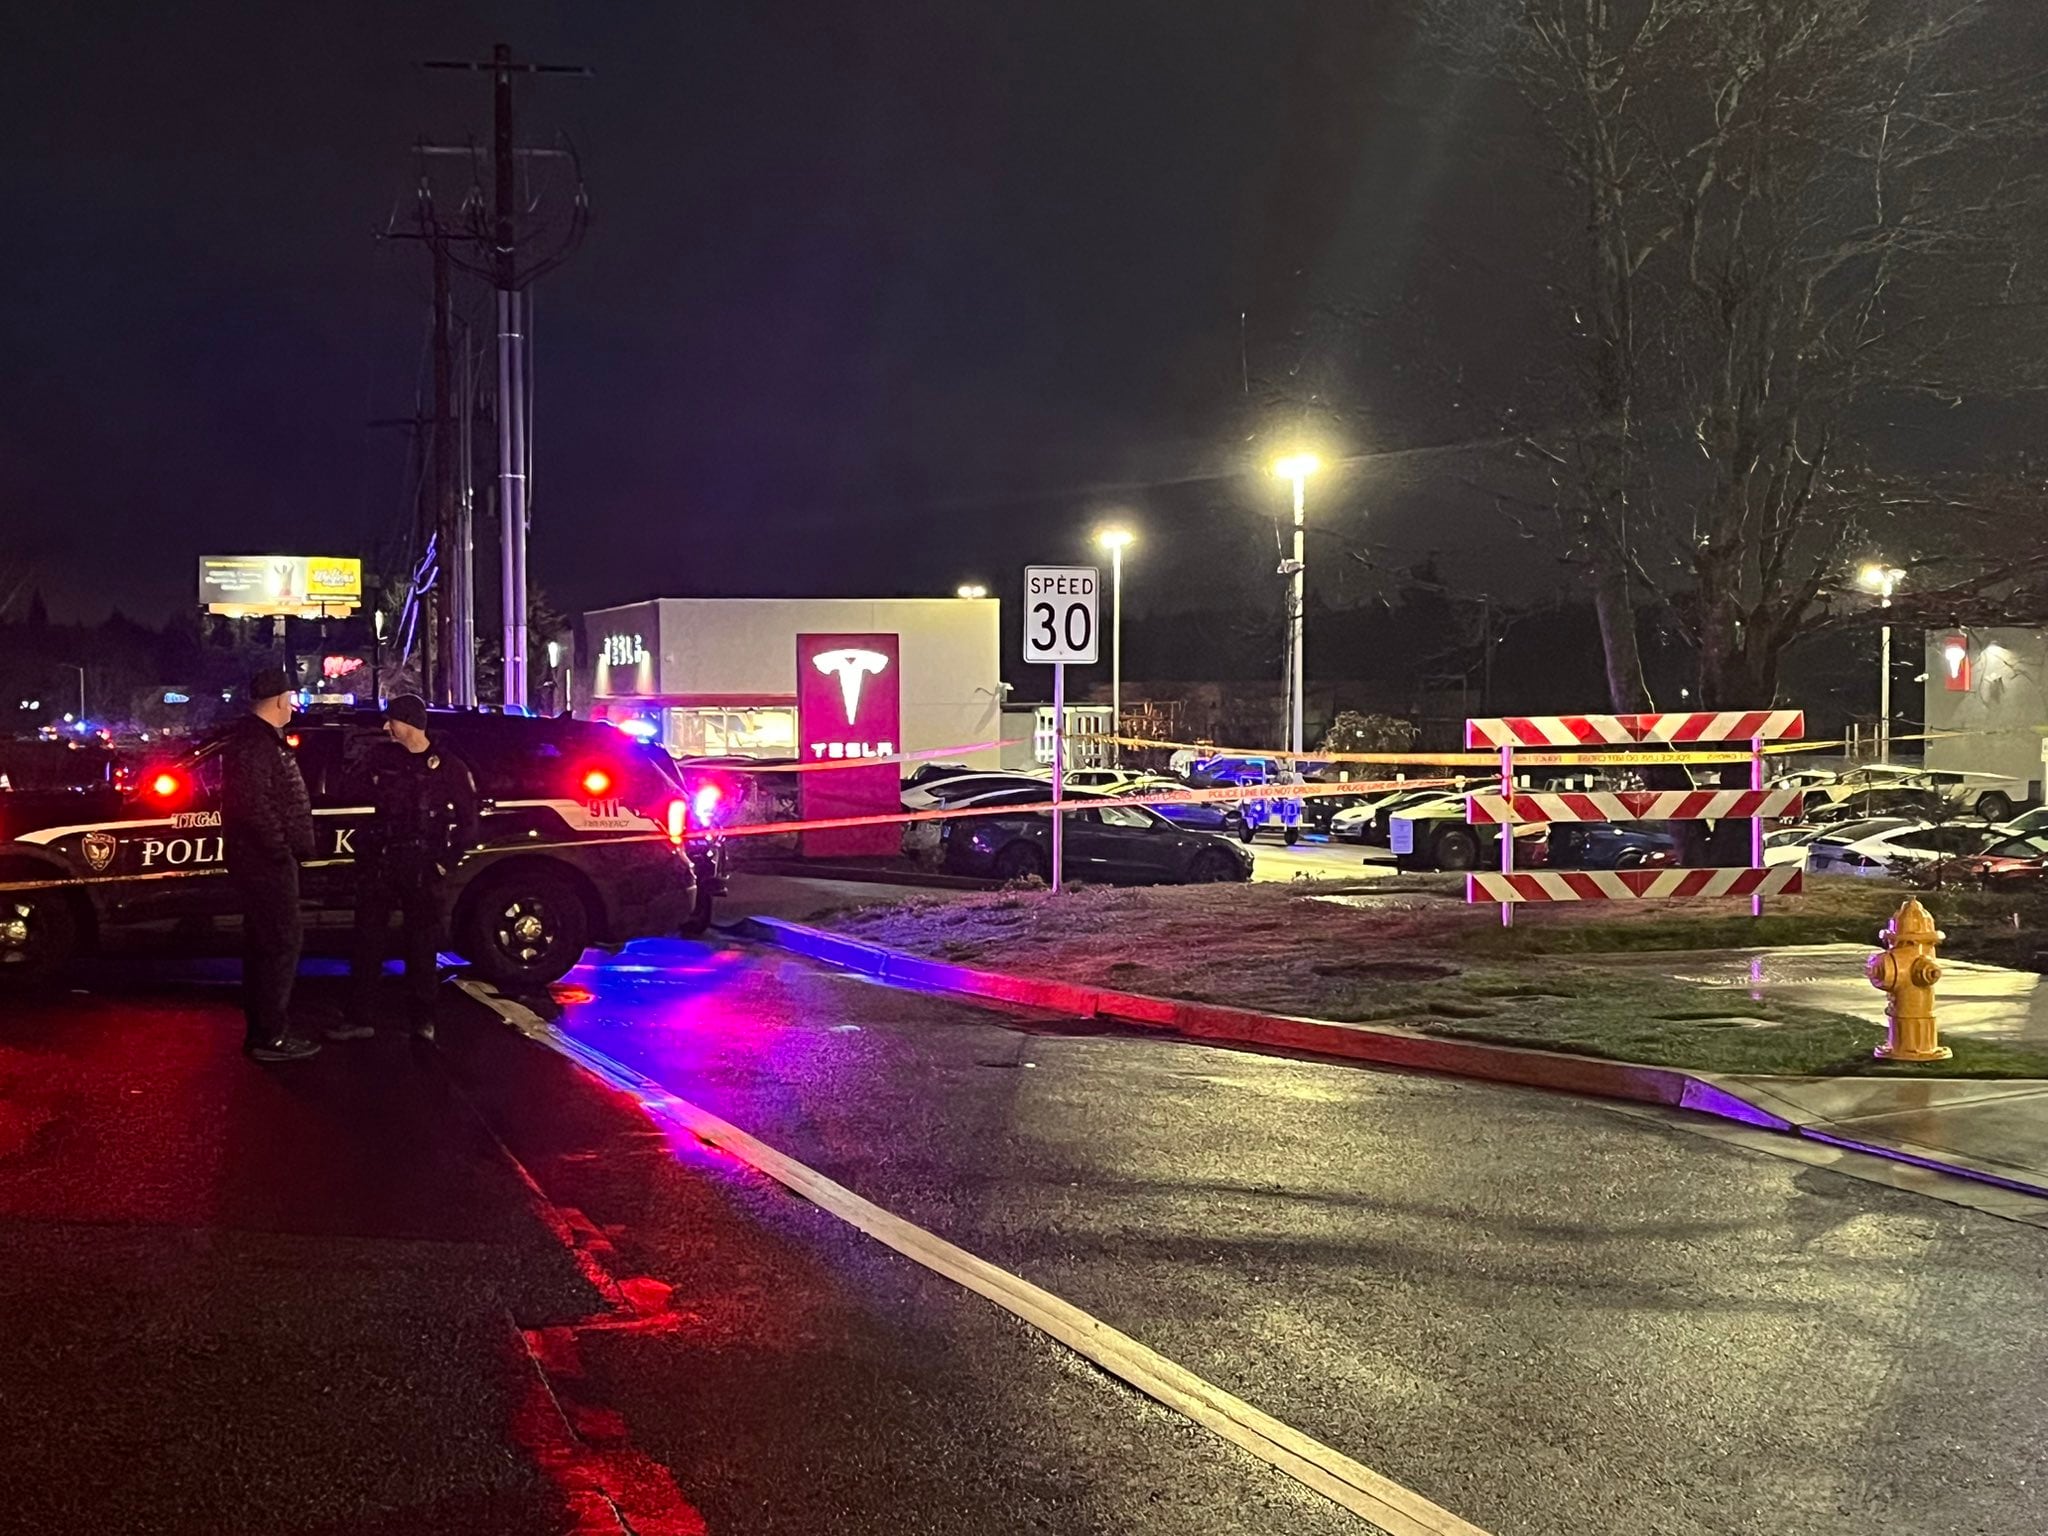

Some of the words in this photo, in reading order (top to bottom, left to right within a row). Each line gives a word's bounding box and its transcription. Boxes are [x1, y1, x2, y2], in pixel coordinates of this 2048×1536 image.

[1031, 577, 1093, 594] SPEED
[1031, 602, 1091, 651] 30
[1208, 789, 1238, 798] POLICE
[1240, 788, 1257, 797] LINE
[1260, 787, 1273, 796] DO
[1274, 786, 1290, 795] NOT
[590, 799, 619, 818] 911
[172, 811, 222, 829] TIGA
[141, 837, 224, 867] POLI
[333, 829, 356, 853] K
